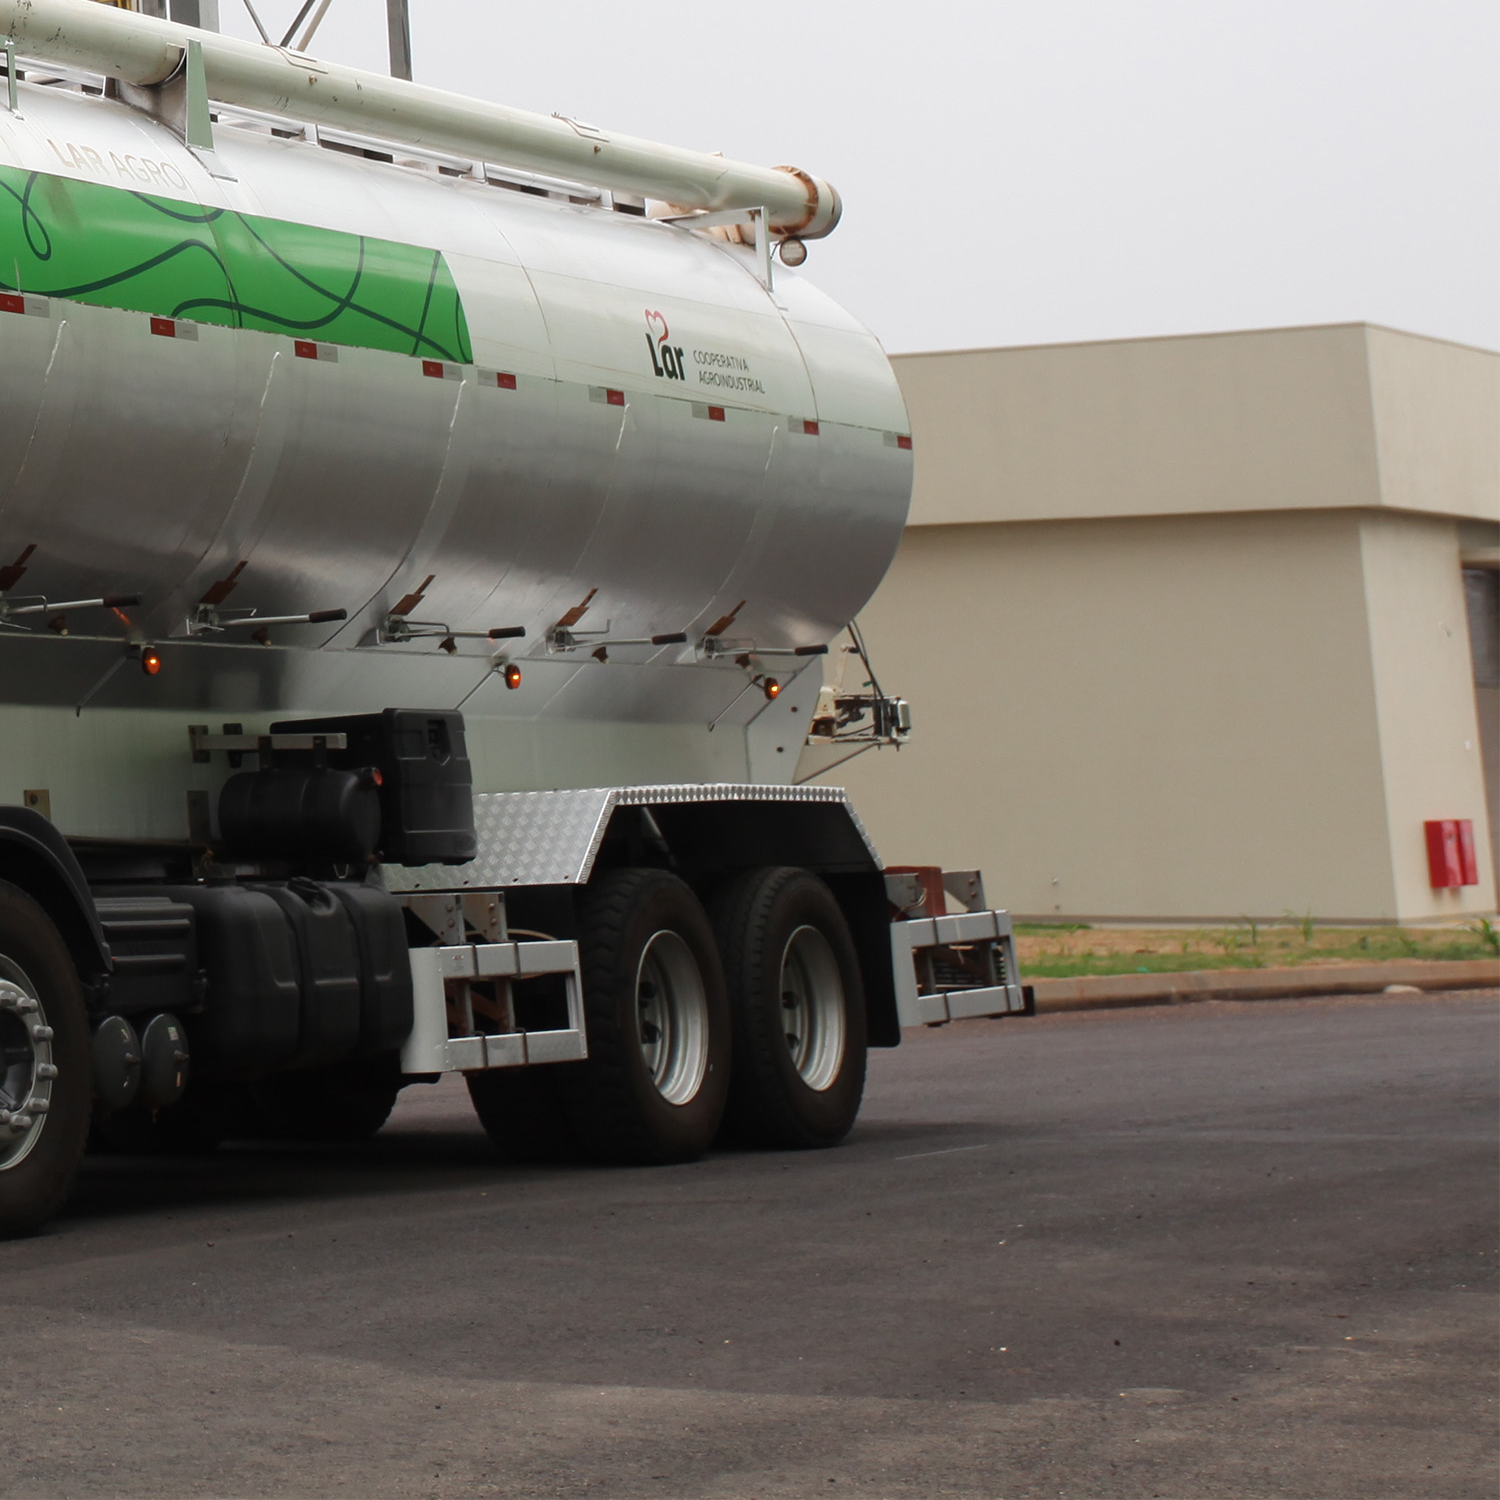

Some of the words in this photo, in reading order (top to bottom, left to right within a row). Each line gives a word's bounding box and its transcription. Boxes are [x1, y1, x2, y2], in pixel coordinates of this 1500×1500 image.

[47, 138, 109, 176] LAR
[109, 151, 187, 190] AGRO
[645, 333, 685, 381] Lar
[693, 350, 749, 372] COOPERATIVA
[699, 370, 765, 394] AGROINDUSTRIAL
